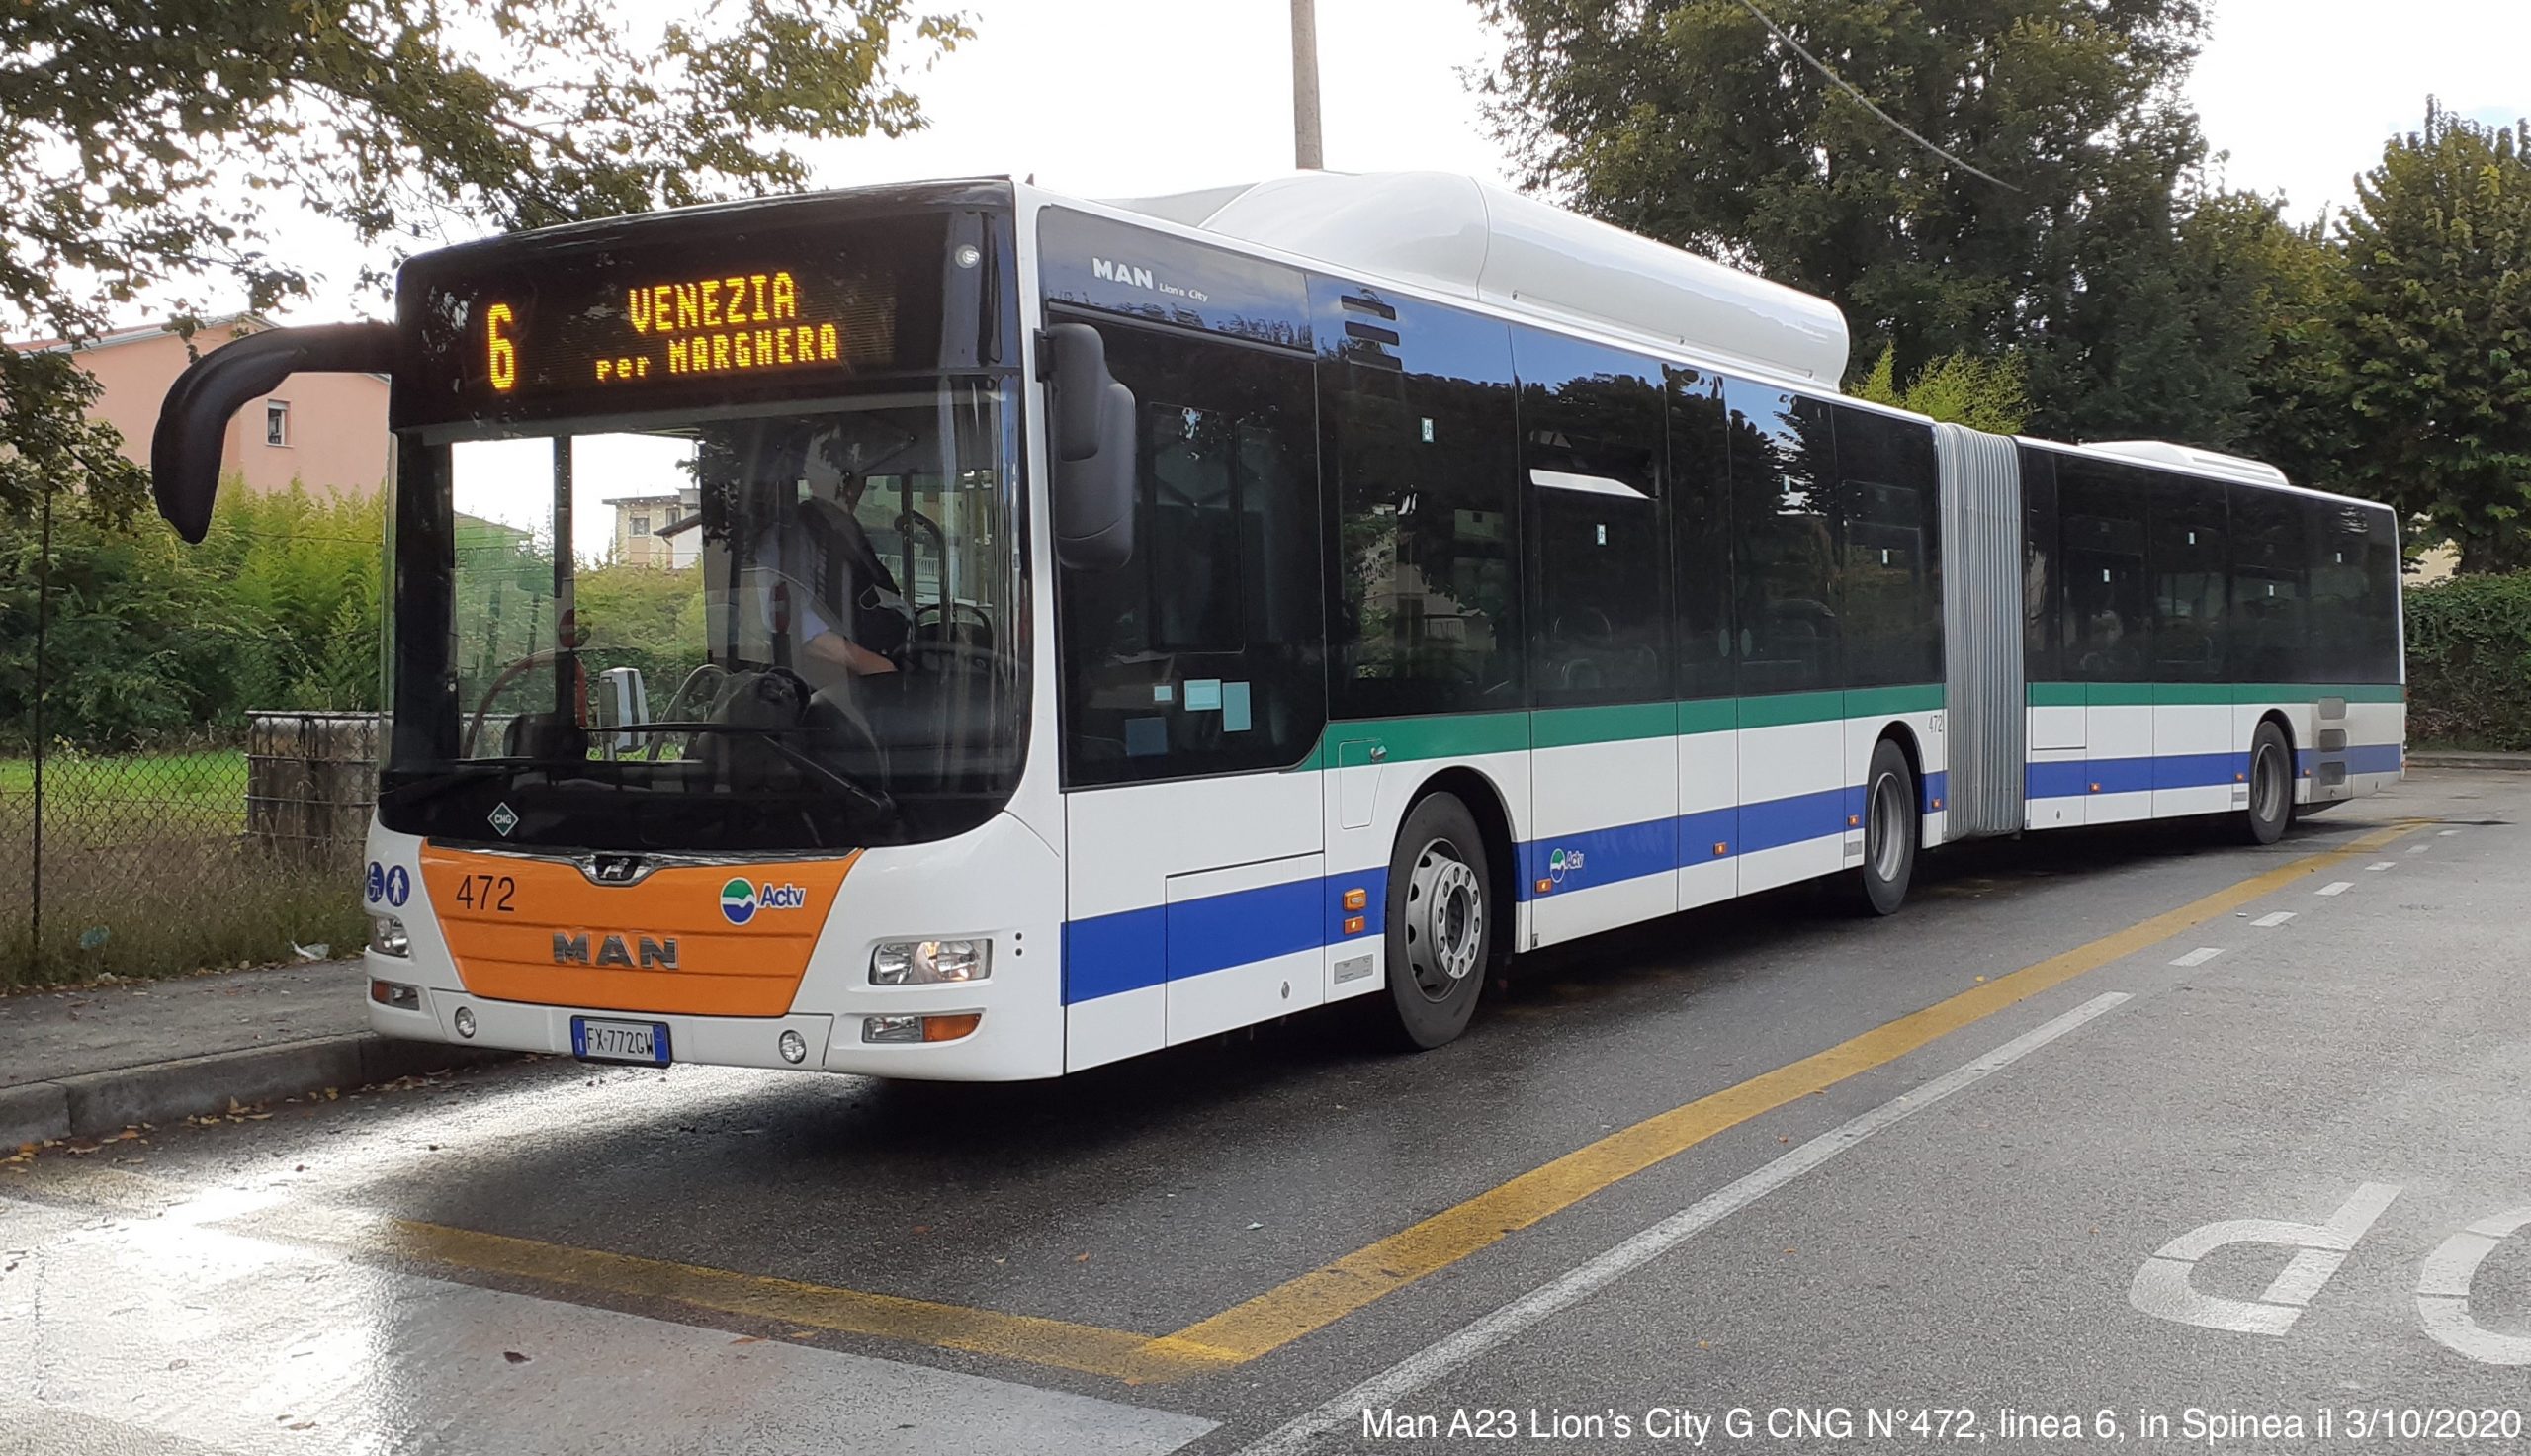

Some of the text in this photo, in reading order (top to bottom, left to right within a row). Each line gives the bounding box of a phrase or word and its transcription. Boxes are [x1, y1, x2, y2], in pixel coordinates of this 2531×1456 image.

[1092, 257, 1208, 302] MAN Lion's City
[629, 271, 796, 334] VENEZIA
[487, 302, 516, 390] 6
[595, 323, 837, 382] per MARGHERA
[1929, 714, 1943, 733] 472
[494, 814, 512, 824] CNG
[456, 874, 515, 912] 472
[758, 882, 807, 909] Actv
[552, 932, 679, 970] MAN
